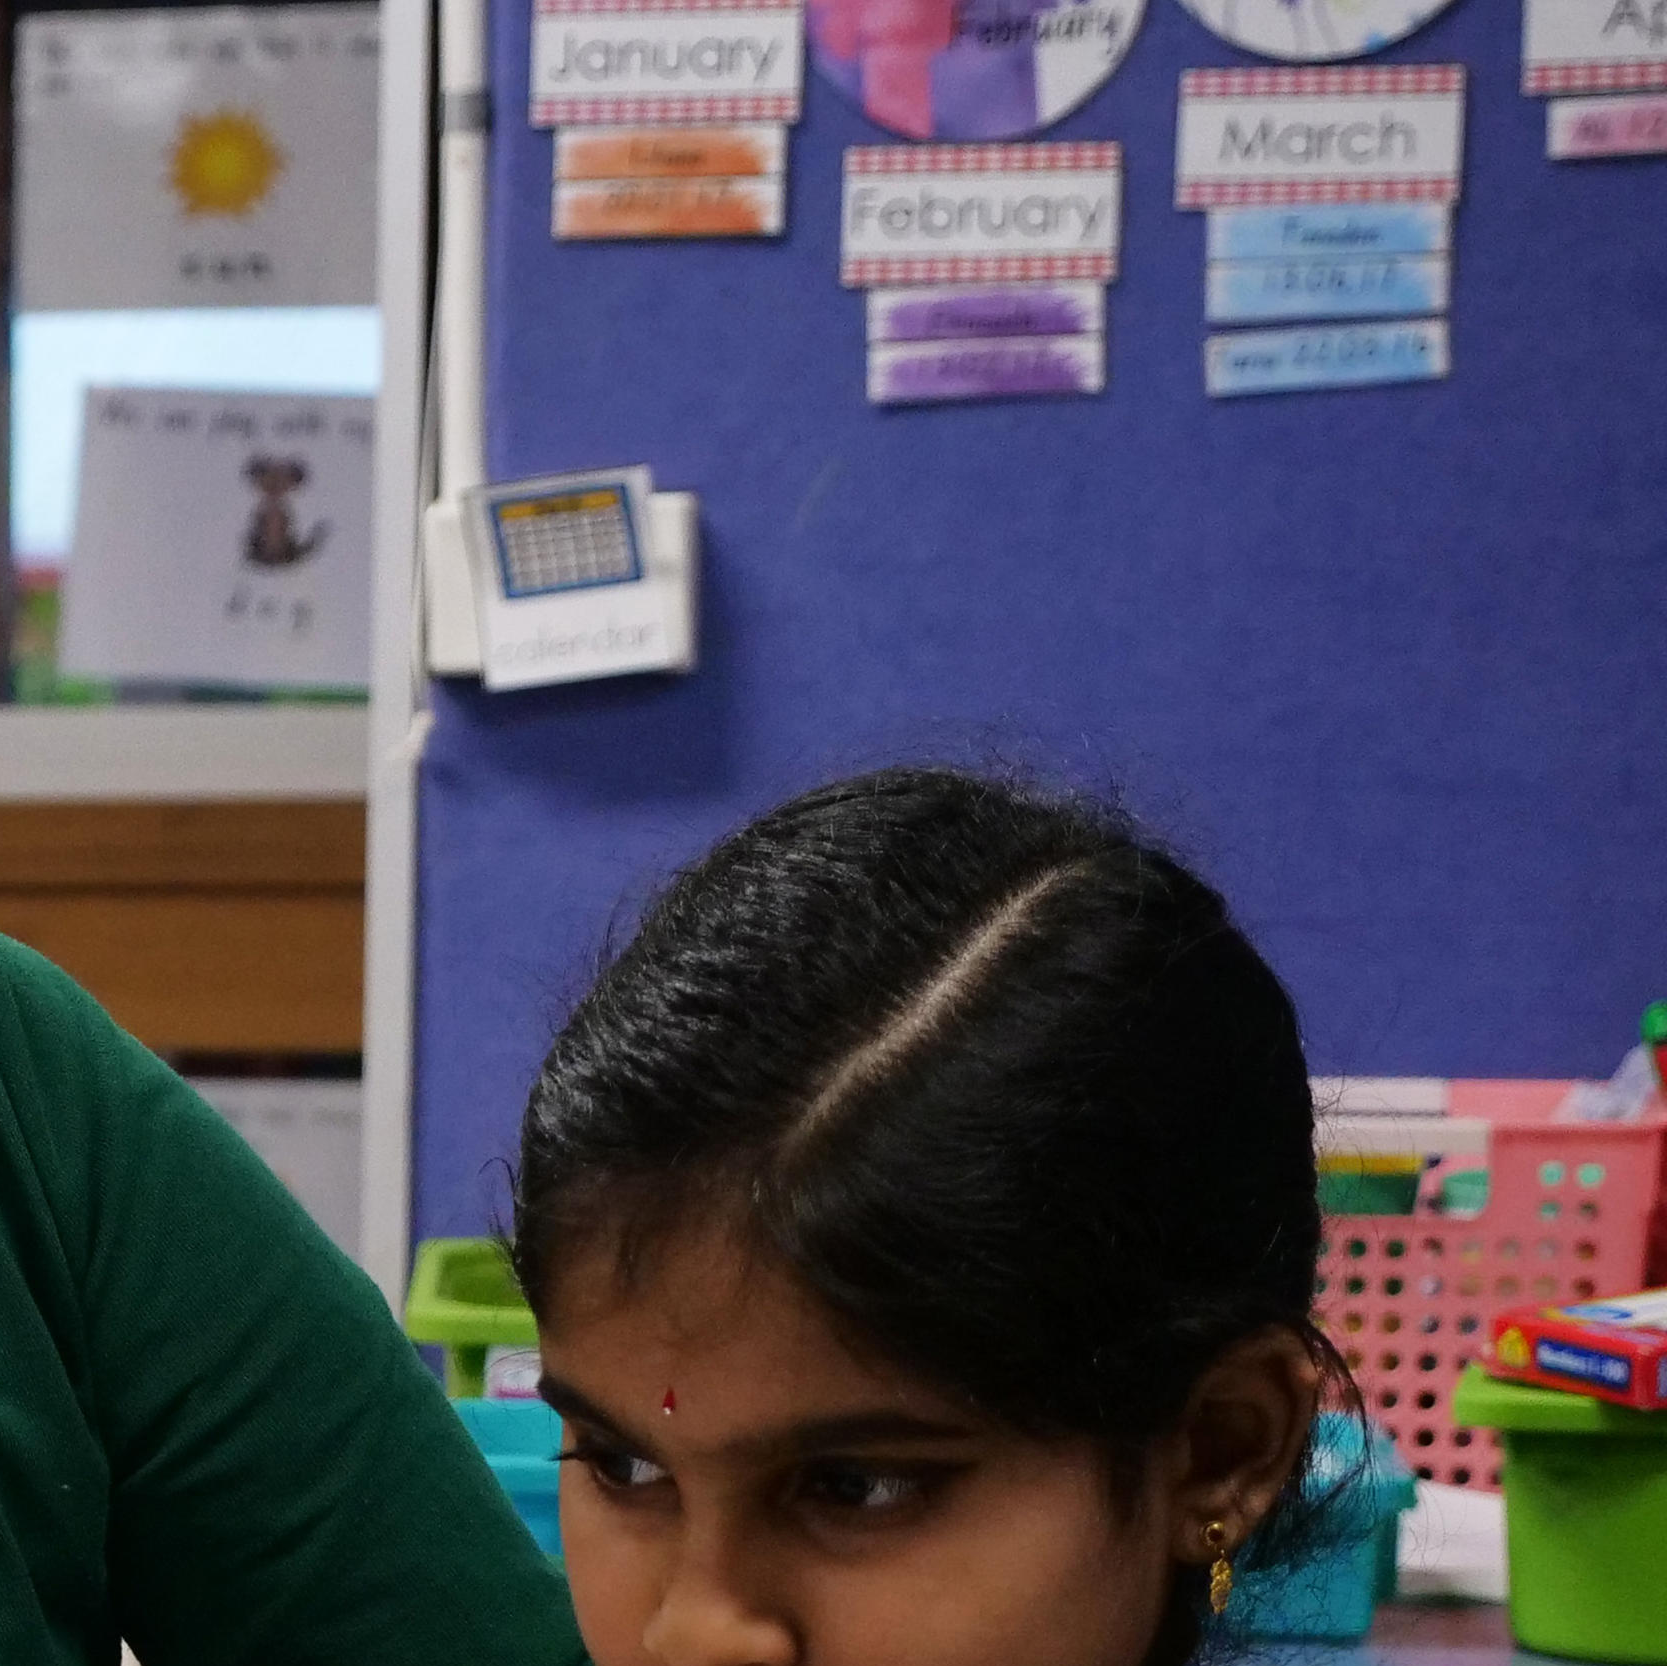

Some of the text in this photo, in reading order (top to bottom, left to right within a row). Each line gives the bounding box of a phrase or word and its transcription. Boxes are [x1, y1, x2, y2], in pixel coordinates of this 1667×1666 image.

[549, 32, 783, 84] January
[1218, 112, 1417, 166] March
[852, 187, 1107, 241] February
